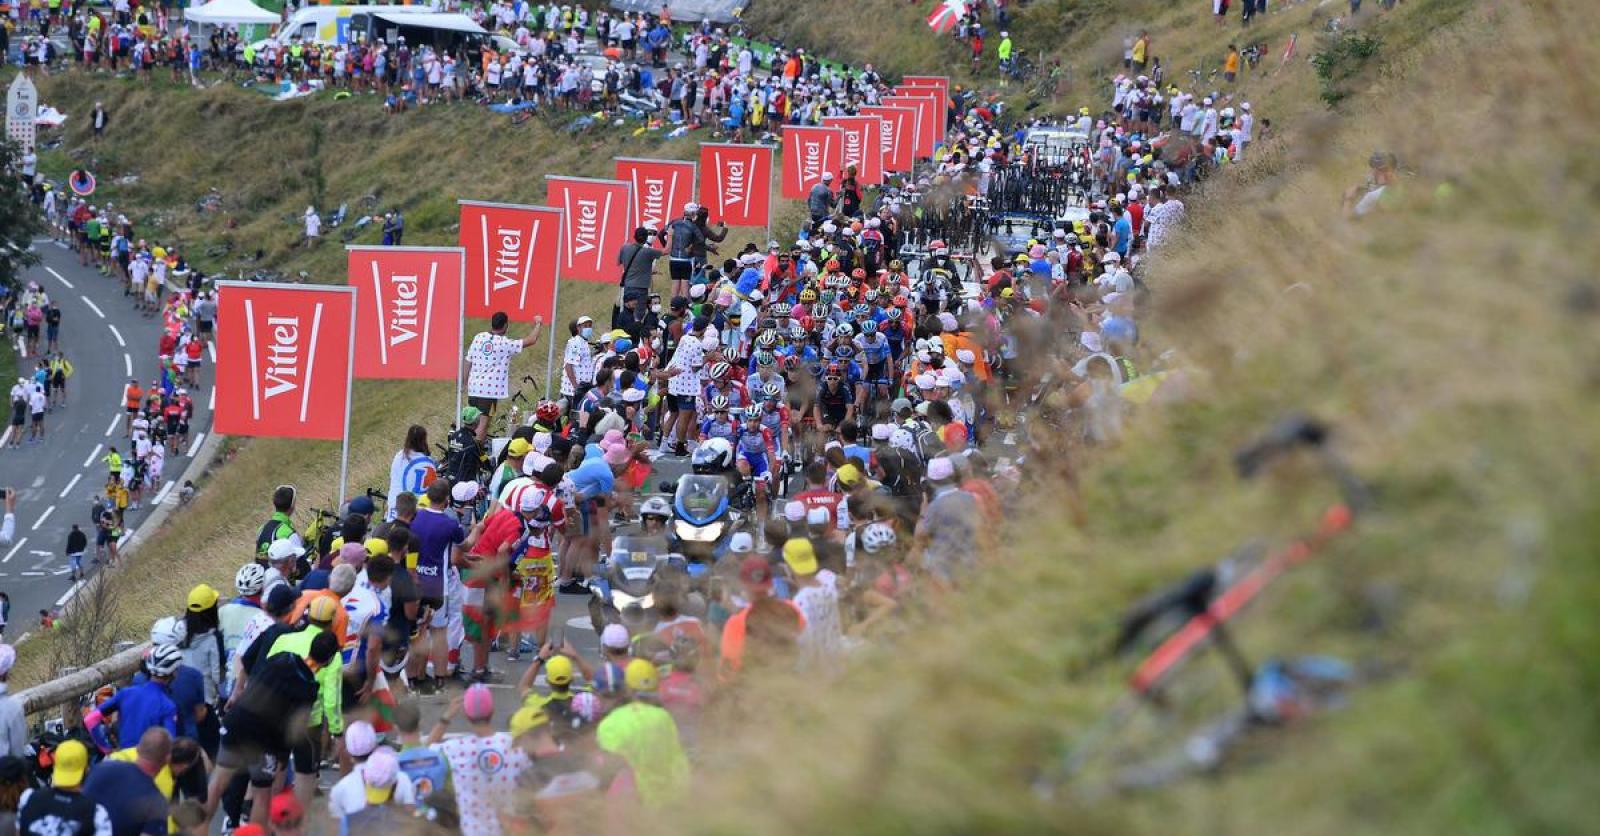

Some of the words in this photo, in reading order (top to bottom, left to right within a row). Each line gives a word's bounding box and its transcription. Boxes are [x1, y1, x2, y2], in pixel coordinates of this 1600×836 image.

[725, 161, 744, 206] Vittel
[803, 141, 819, 181] Vittel
[575, 200, 597, 255] Vittel
[642, 179, 664, 231] Vittel
[493, 228, 521, 292] Vittel
[391, 275, 418, 346] Vittel
[264, 316, 299, 399] Vittel
